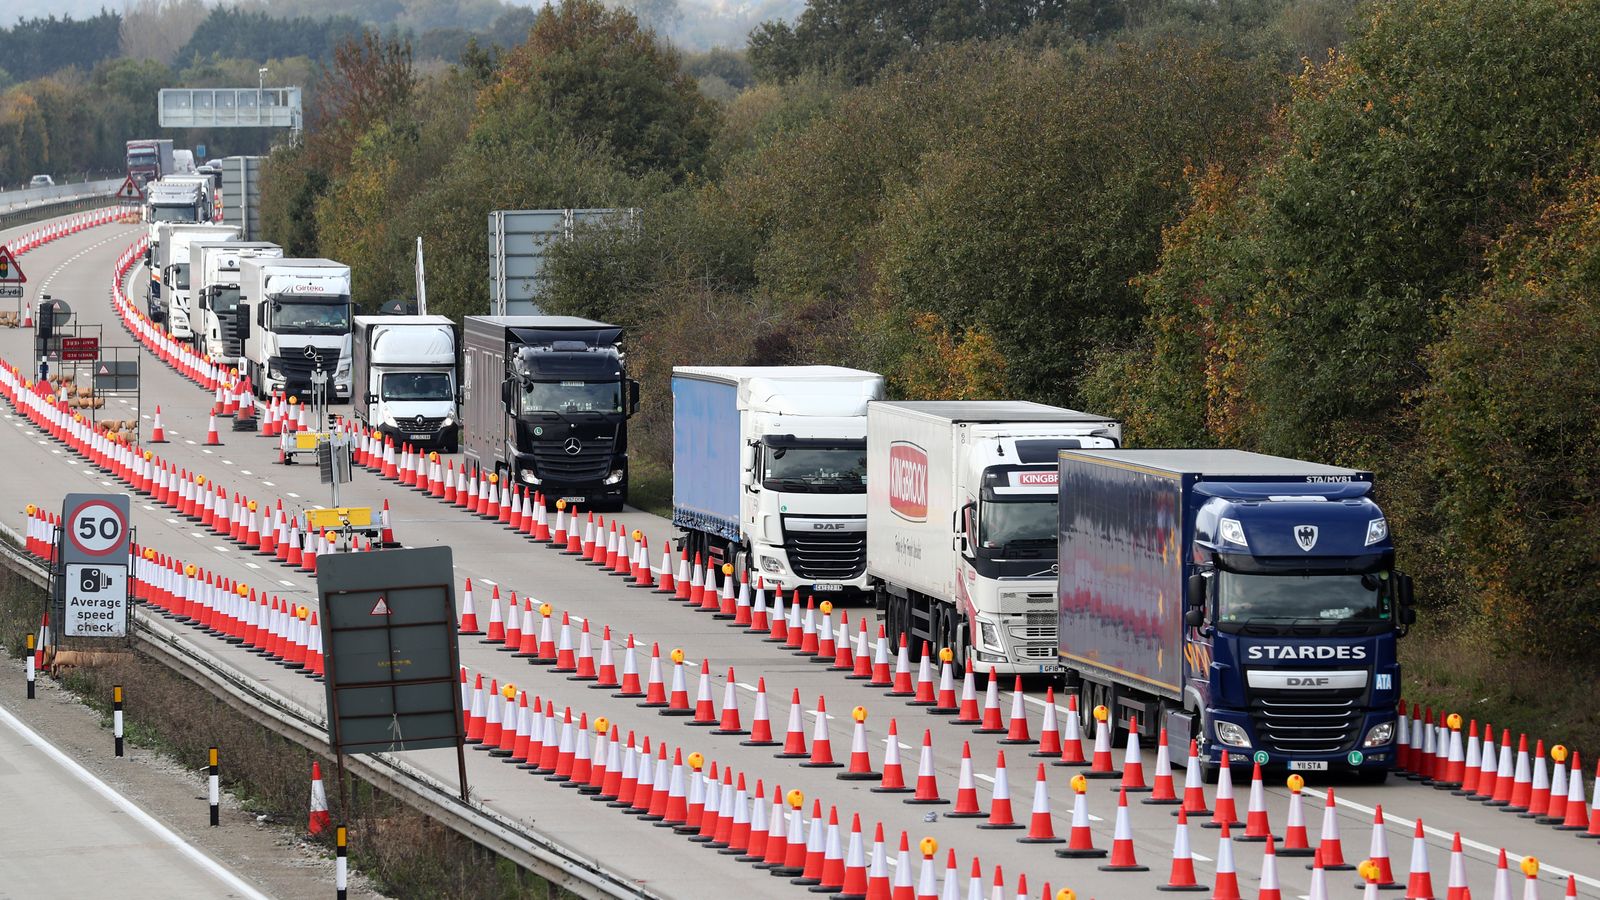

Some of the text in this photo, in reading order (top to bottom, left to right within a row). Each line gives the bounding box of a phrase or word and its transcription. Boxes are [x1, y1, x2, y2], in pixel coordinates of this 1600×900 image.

[891, 456, 927, 507] KINGBROOK
[79, 517, 119, 540] 50
[70, 596, 122, 610] Average
[77, 610, 114, 620] speed
[77, 622, 114, 633] check
[1248, 645, 1367, 660] STARDES
[1286, 677, 1330, 687] DAF
[1375, 673, 1392, 690] ATA
